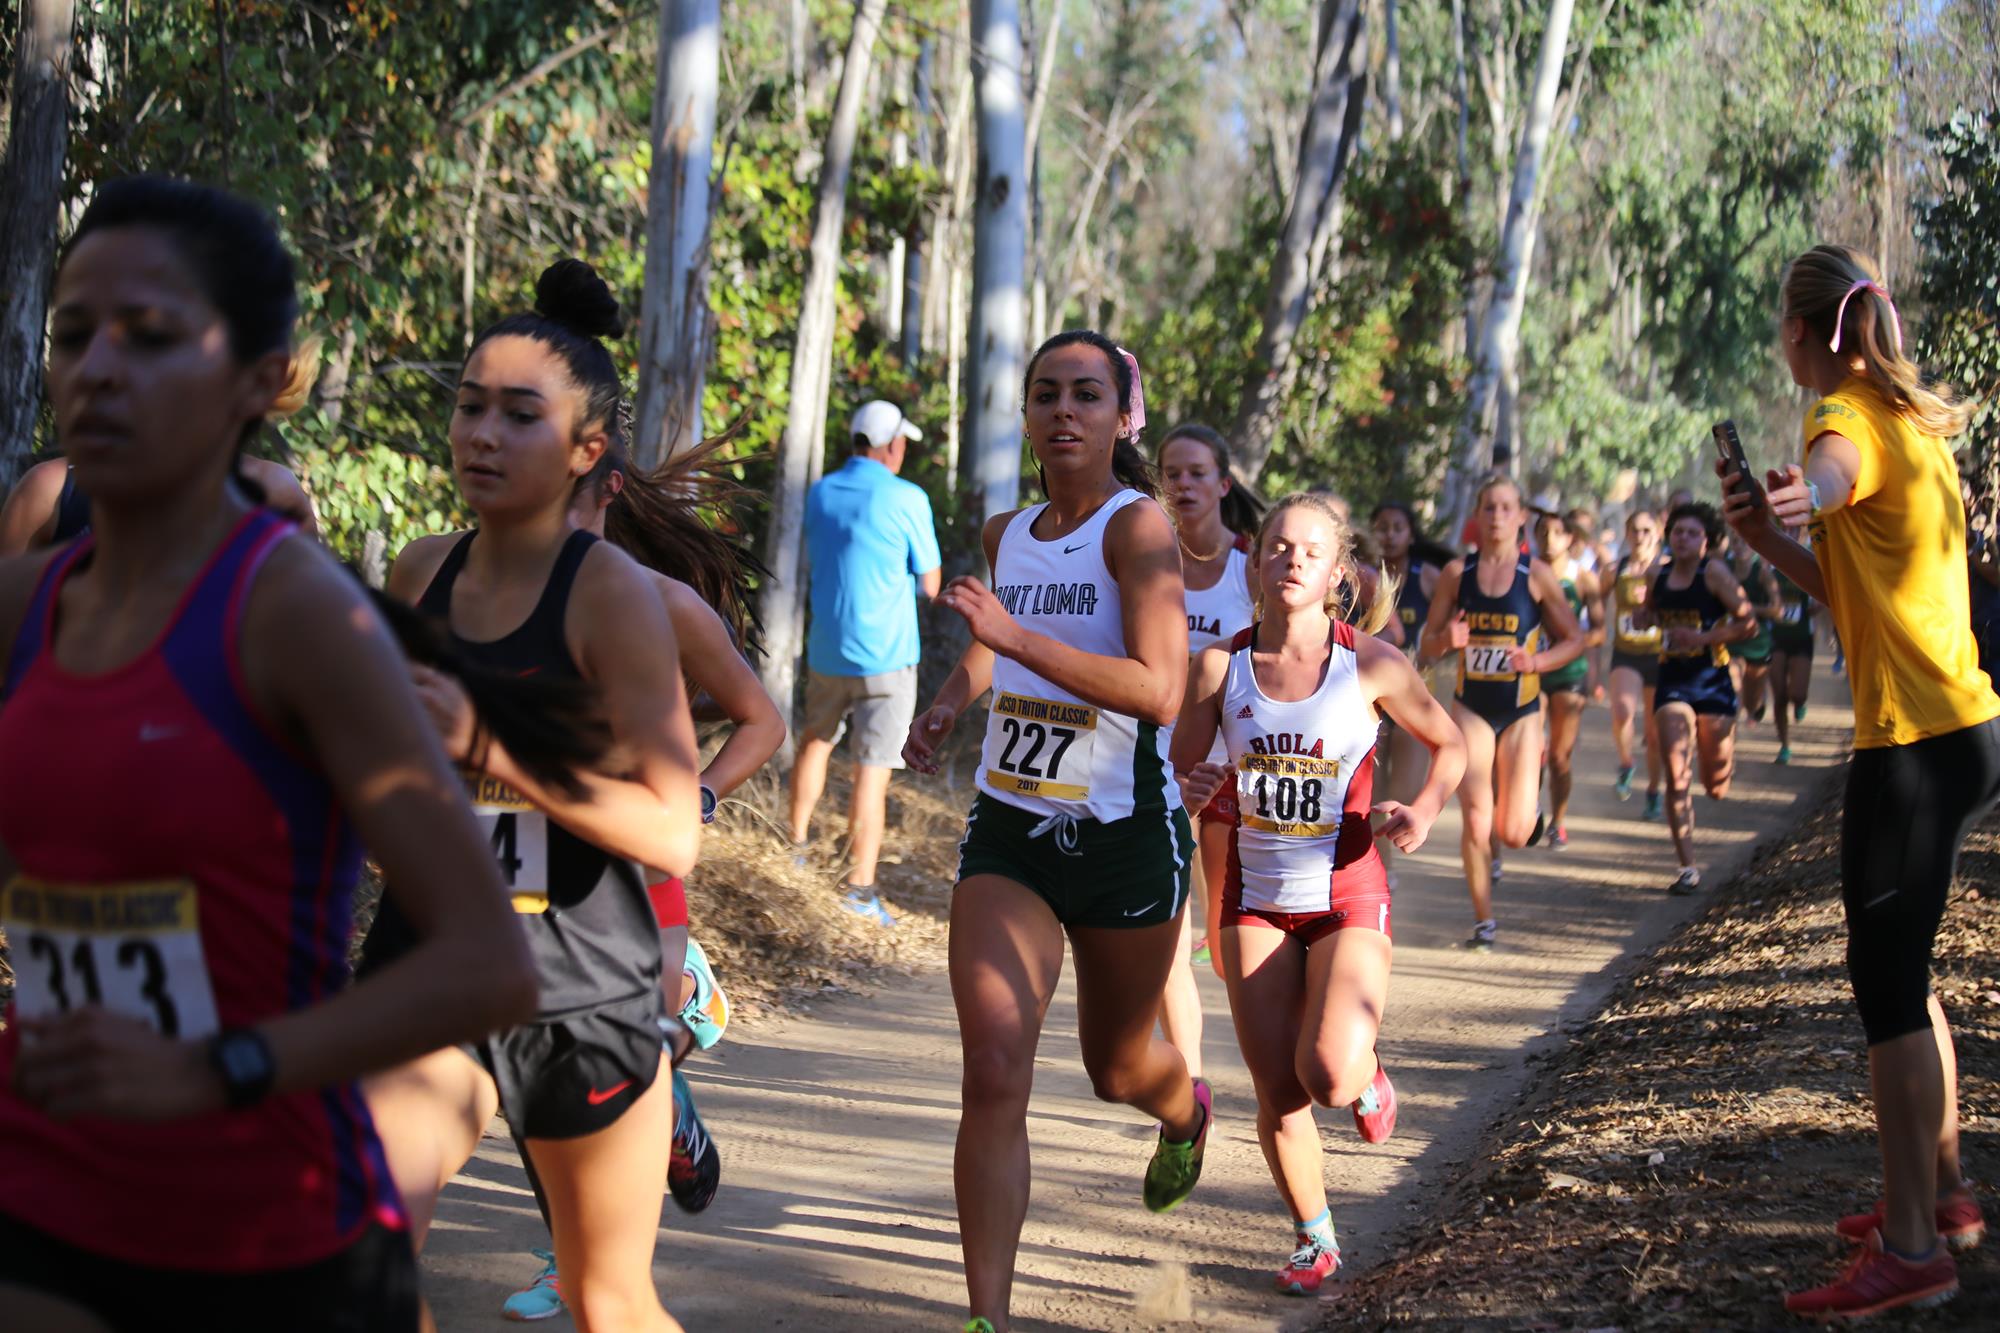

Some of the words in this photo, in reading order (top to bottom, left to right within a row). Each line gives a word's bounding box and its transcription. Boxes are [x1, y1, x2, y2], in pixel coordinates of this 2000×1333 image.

[1031, 583, 1099, 615] LOMA
[1187, 615, 1221, 636] OLA
[1472, 648, 1511, 672] 272
[1018, 698, 1048, 719] TRITON
[1049, 704, 1089, 726] CLASSIC
[998, 718, 1076, 779] 227
[1250, 733, 1324, 759] BIOLA
[1300, 761, 1333, 775] CLASSIC
[1017, 779, 1040, 792] 2017
[1254, 774, 1322, 823] 108
